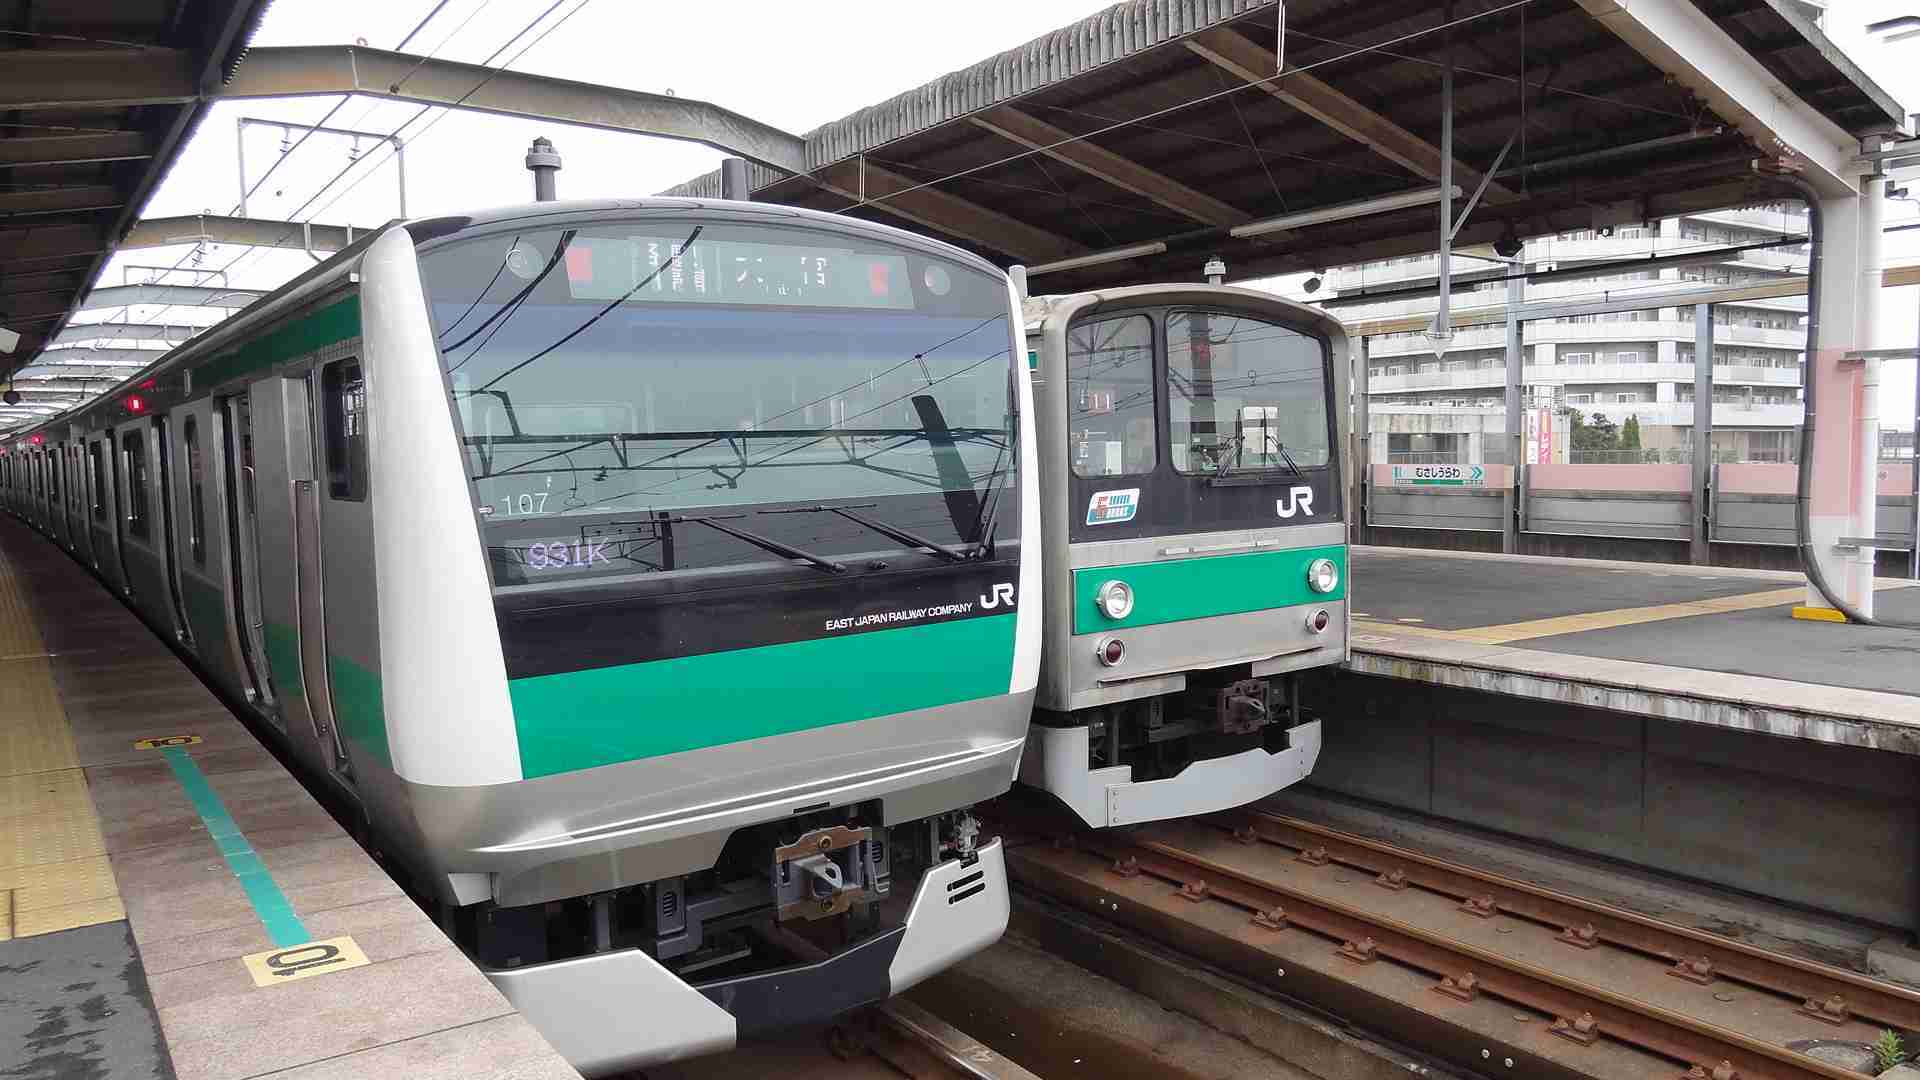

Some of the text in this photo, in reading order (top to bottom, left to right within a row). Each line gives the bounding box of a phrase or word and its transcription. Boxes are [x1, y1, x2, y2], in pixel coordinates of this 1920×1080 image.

[1415, 466, 1461, 478] むさしうらわ
[500, 492, 549, 516] 107
[1276, 486, 1315, 518] JR
[980, 583, 1015, 609] JR
[826, 603, 973, 631] EAST JAPAN RAILWAY COMPANY
[267, 945, 346, 976] 10
